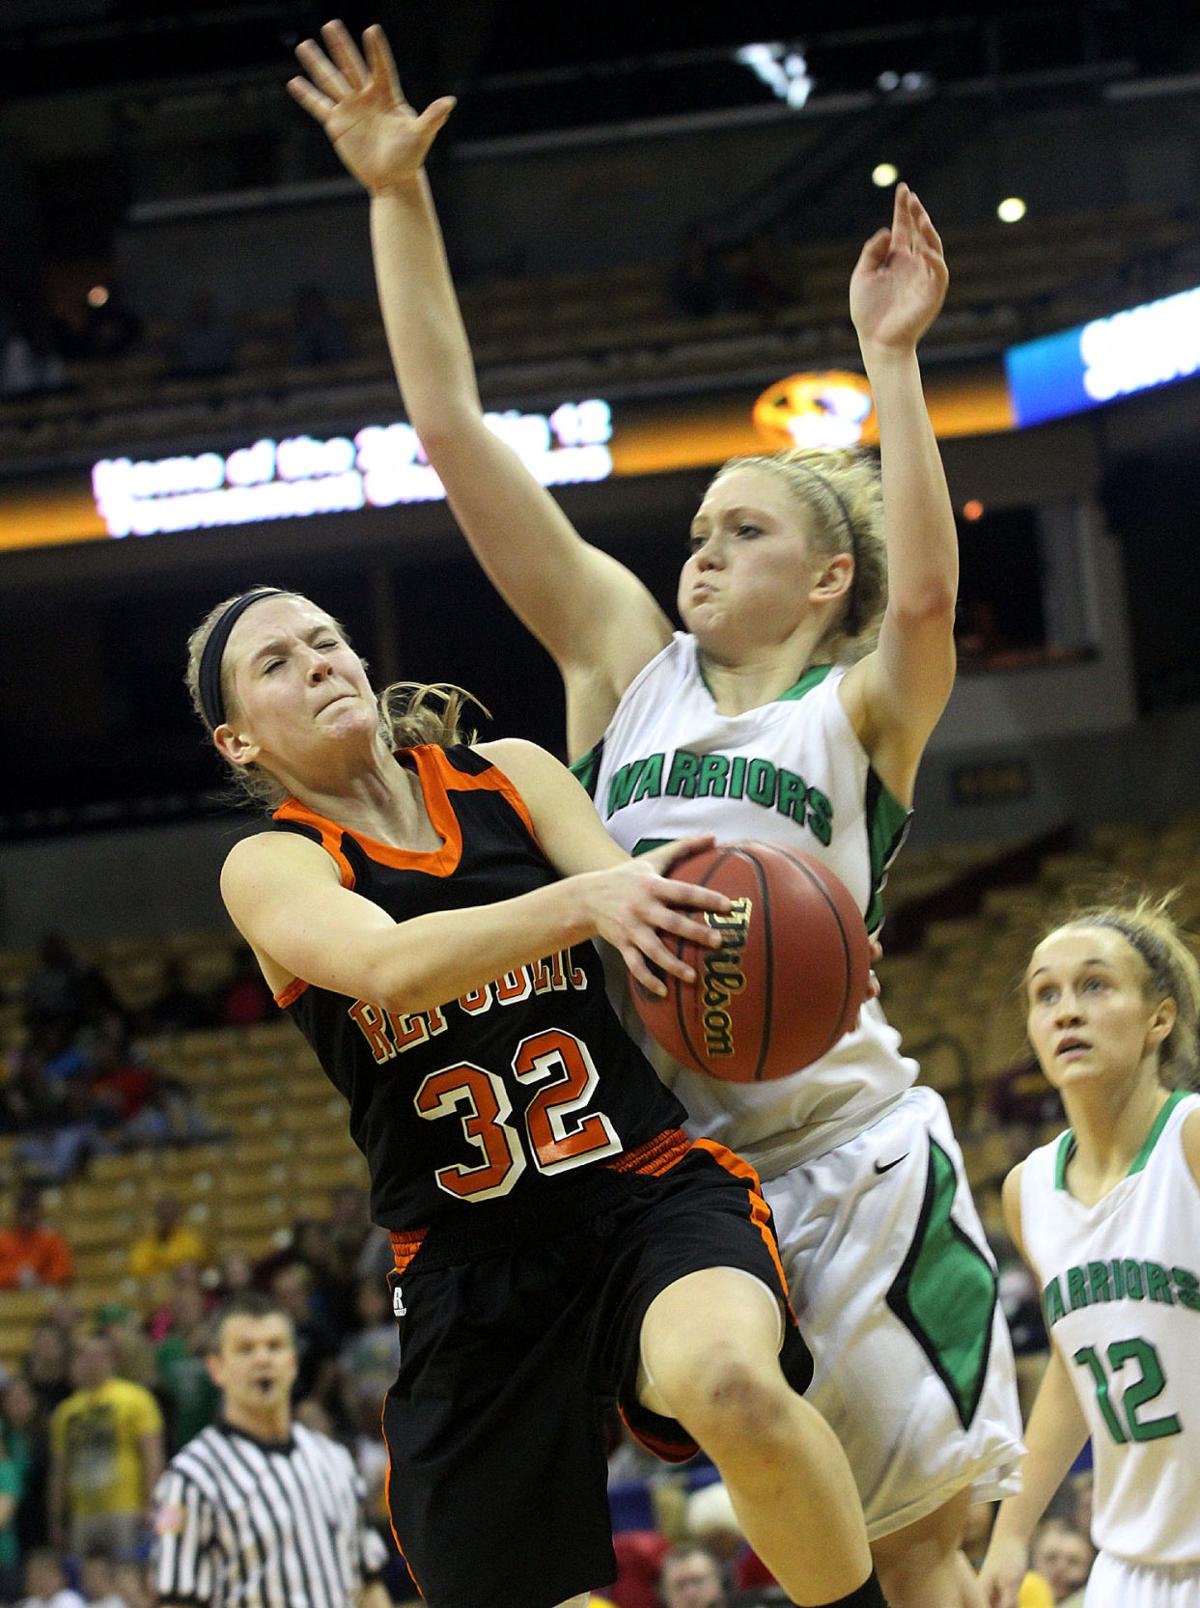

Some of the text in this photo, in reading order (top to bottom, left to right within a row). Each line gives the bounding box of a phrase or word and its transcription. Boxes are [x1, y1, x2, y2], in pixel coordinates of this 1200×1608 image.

[606, 749, 833, 848] WARRIORS
[413, 1027, 623, 1203] 32
[1043, 1257, 1200, 1327] ARRIORS
[1073, 1337, 1183, 1444] 12
